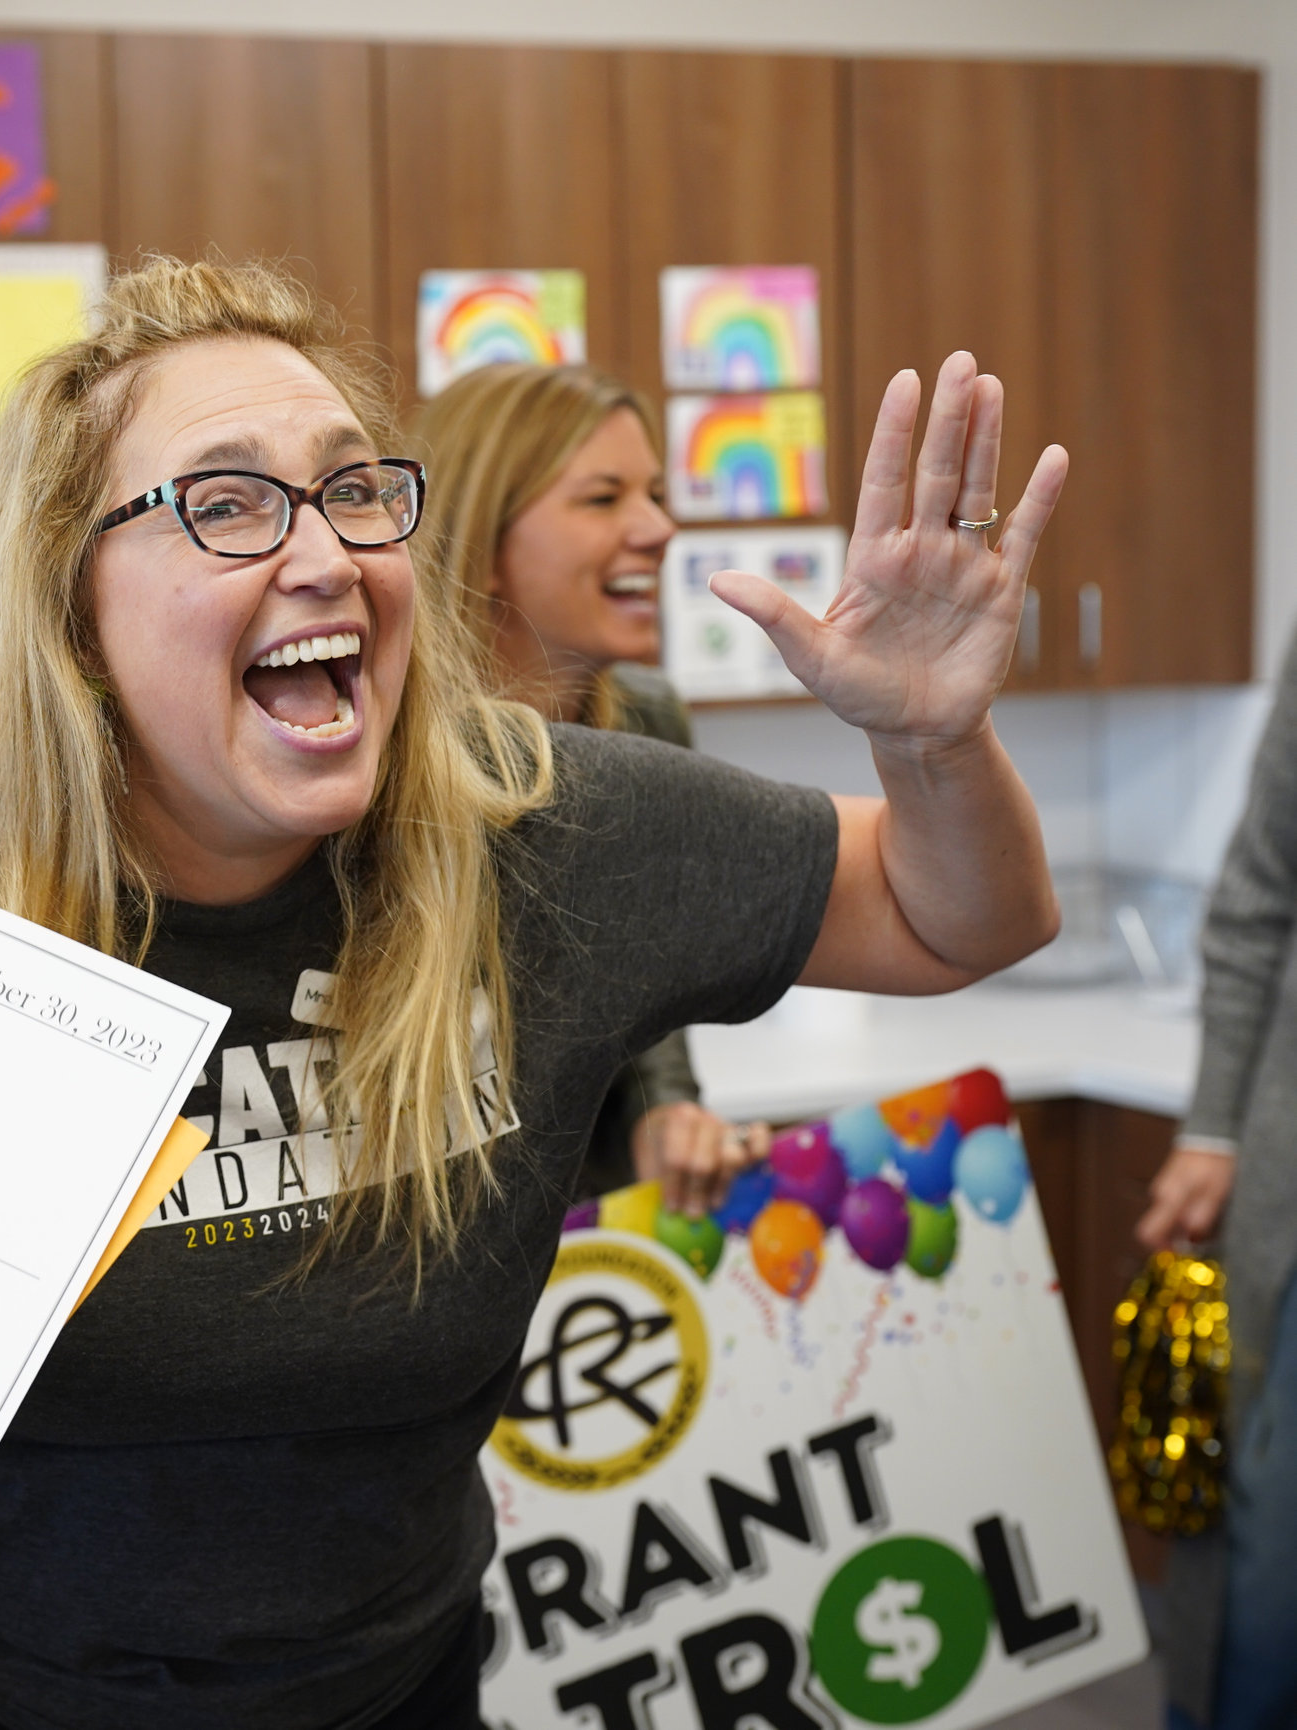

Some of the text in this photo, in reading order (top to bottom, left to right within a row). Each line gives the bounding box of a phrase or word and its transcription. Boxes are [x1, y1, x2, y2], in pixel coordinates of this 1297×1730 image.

[39, 994, 78, 1034] 30,
[90, 1015, 163, 1066] 2023
[481, 1411, 892, 1672] RANT
